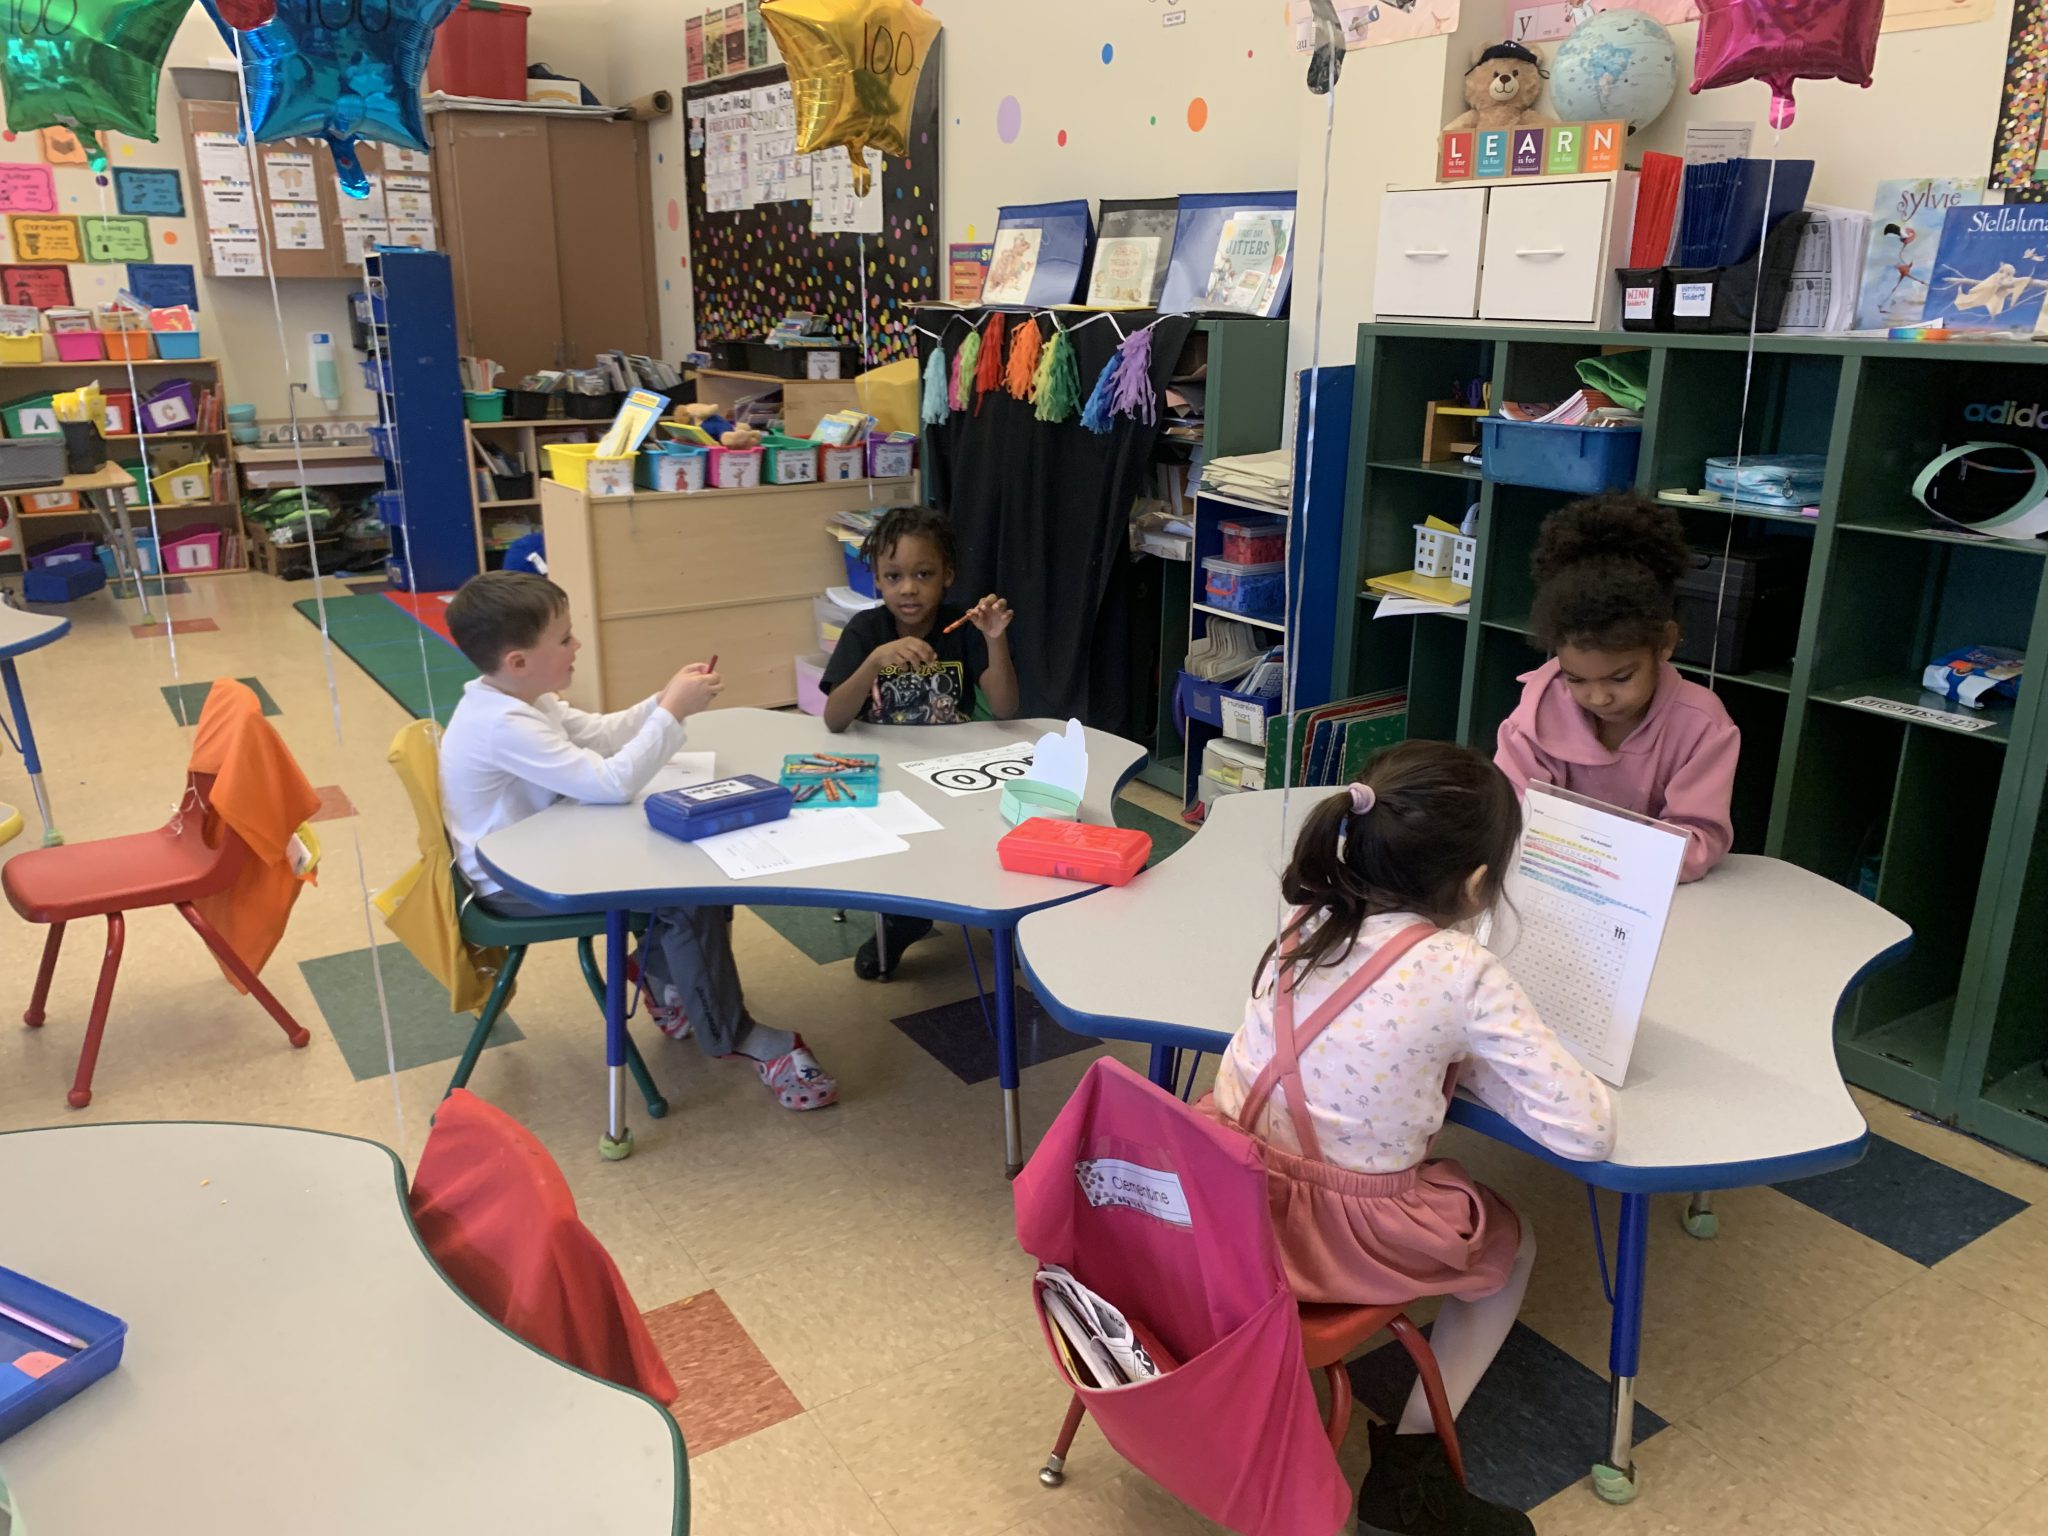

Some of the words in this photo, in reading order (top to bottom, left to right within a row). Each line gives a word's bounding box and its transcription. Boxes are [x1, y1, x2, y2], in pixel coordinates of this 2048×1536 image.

[1517, 15, 1533, 41] y
[864, 21, 914, 76] 100
[1525, 155, 1536, 164] for
[1226, 239, 1270, 255] JITTERS
[162, 405, 177, 422] C
[1964, 400, 2048, 429] adida
[33, 414, 49, 431] A
[1614, 926, 1627, 941] th
